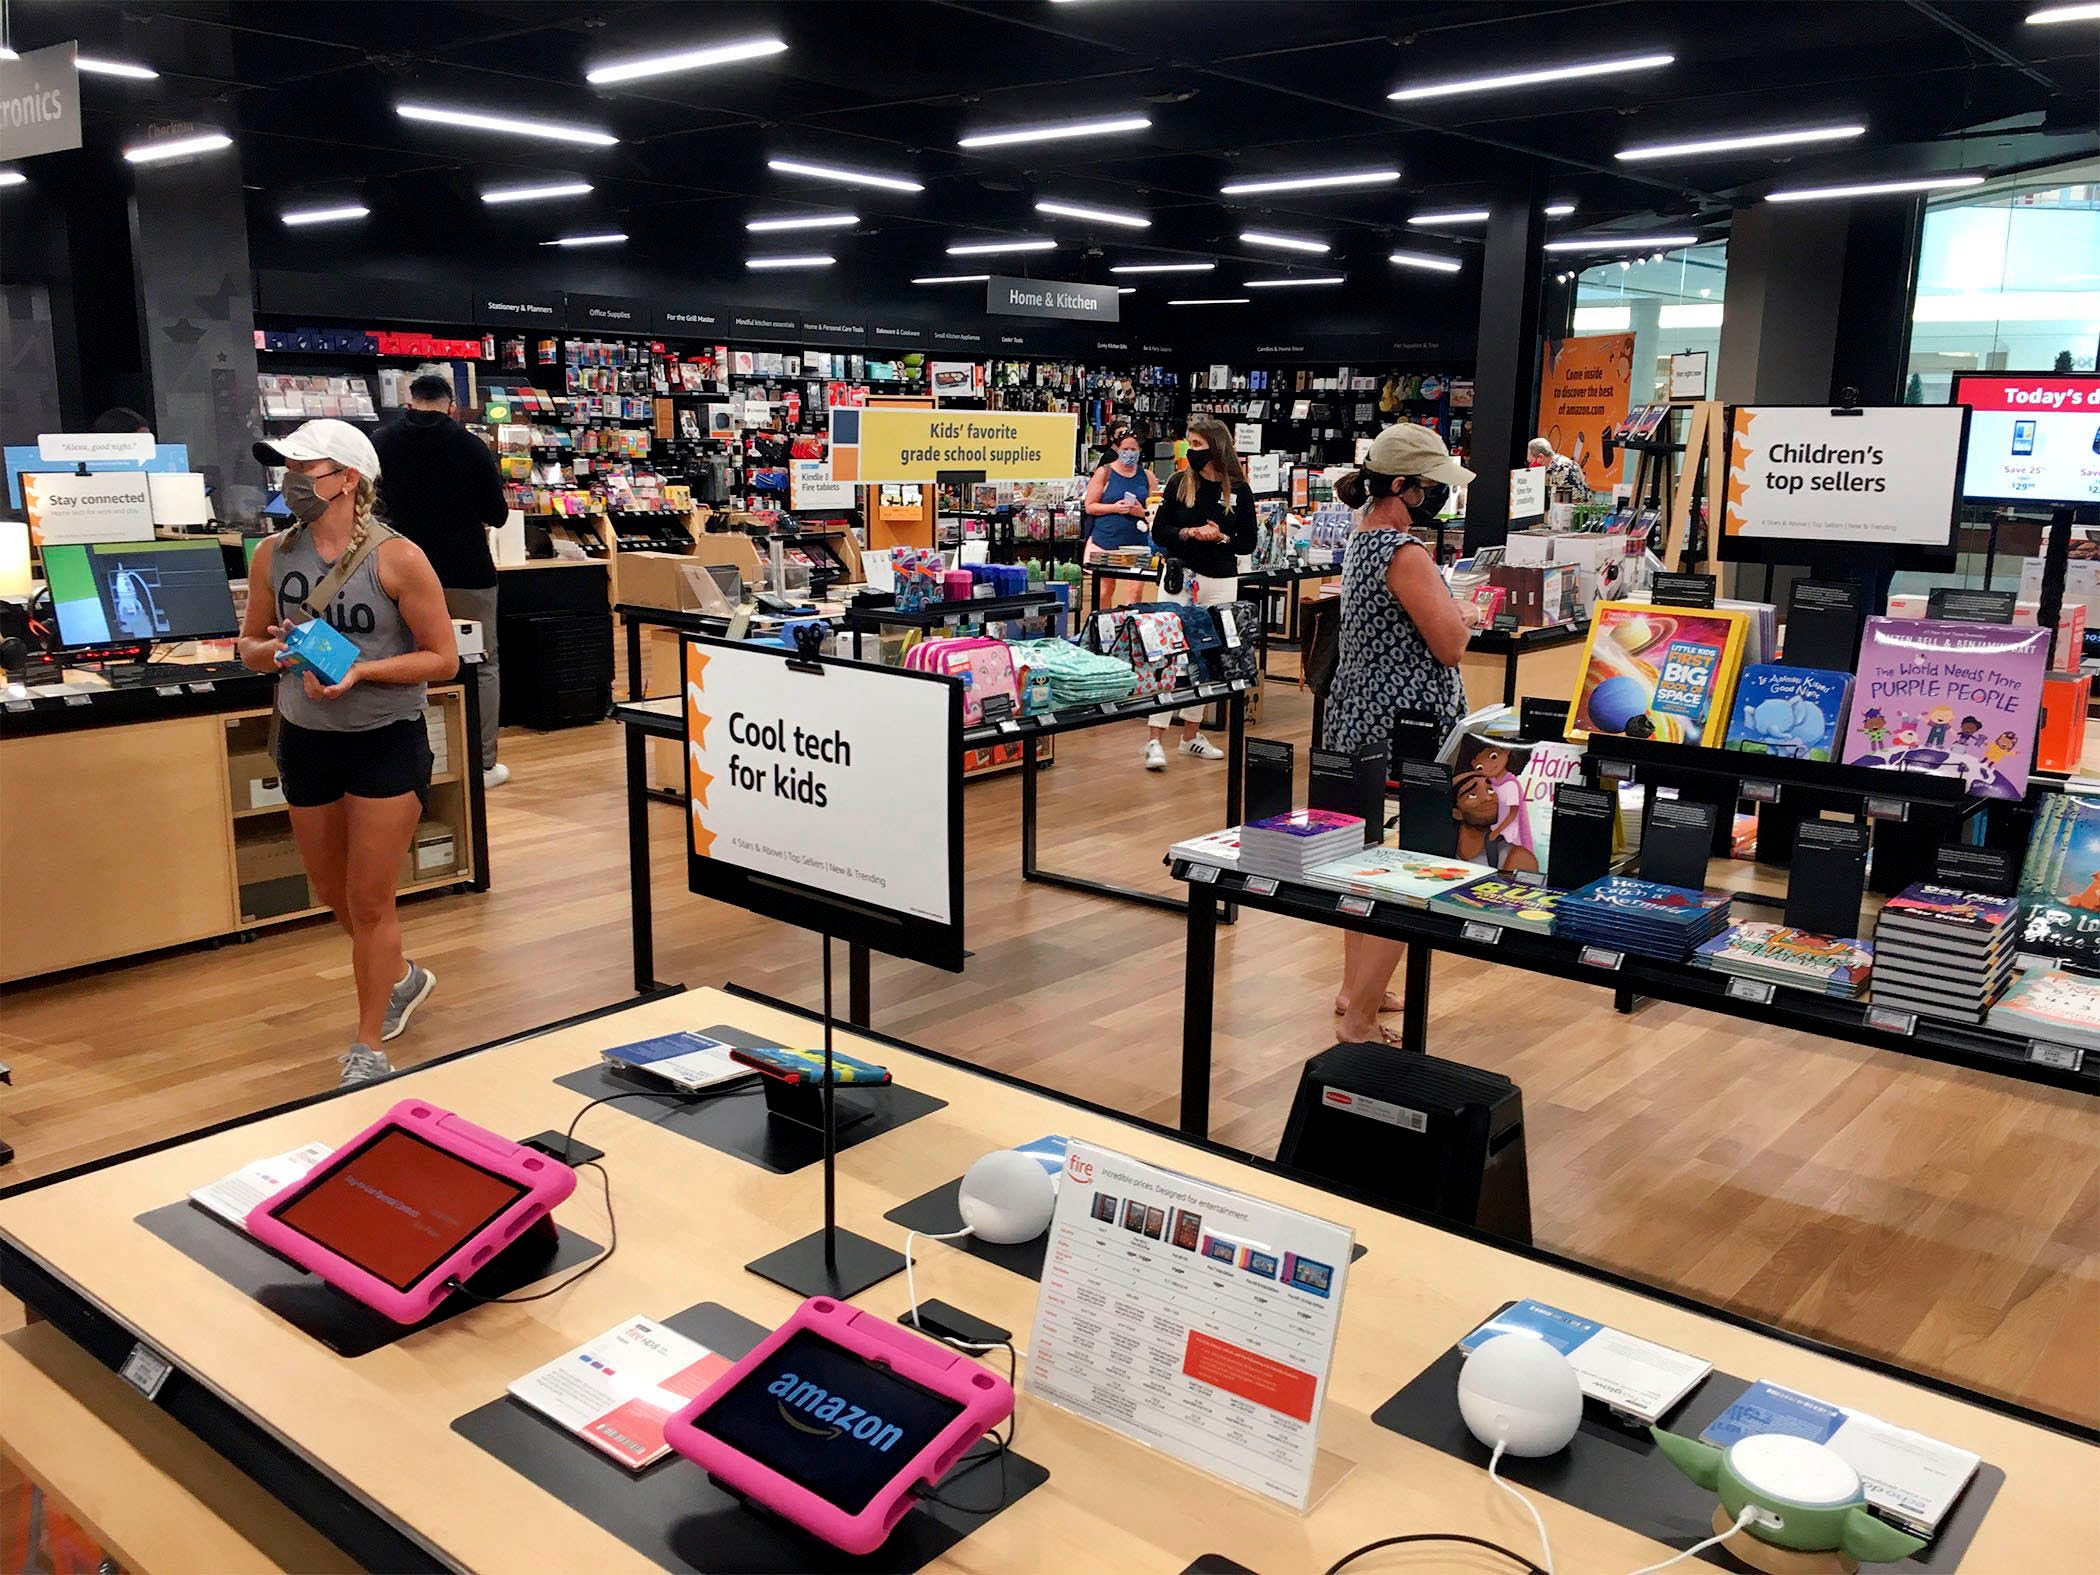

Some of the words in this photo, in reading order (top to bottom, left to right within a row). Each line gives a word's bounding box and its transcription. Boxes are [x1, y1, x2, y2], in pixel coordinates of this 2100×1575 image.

[1009, 289, 1042, 306] Home
[1045, 292, 1054, 307] &
[1056, 293, 1098, 310] Kitchen
[488, 302, 519, 312] Stationery
[527, 305, 552, 314] Planners
[589, 309, 606, 317] Office
[607, 310, 631, 319] Supplies
[755, 319, 772, 327] kitchen
[824, 324, 841, 332] Personal
[1566, 368, 1583, 381] Come
[1584, 367, 1603, 380] inside
[1554, 387, 1562, 398] to
[1562, 386, 1587, 398] discover
[1588, 386, 1598, 397] the
[1599, 386, 1614, 397] best
[2004, 388, 2082, 408] Today's
[1558, 403, 1565, 415] of
[1566, 404, 1605, 416] amazon.com
[930, 423, 965, 439] Kids'
[967, 423, 1017, 440] favorite
[92, 443, 109, 452] good
[1769, 443, 1883, 465] Children's
[901, 447, 940, 465] grade
[944, 446, 986, 462] school
[989, 448, 1041, 466] supplies
[802, 472, 823, 481] Kindle
[2004, 466, 2026, 474] Save
[802, 483, 815, 491] Fire
[816, 482, 840, 491] tablets
[1766, 472, 1803, 494] top
[1810, 472, 1886, 492] sellers
[49, 494, 76, 508] Stay
[81, 492, 144, 505] connected
[1871, 523, 1896, 531] Trending
[1671, 644, 1697, 654] LITTLE
[1699, 648, 1716, 657] KIDS
[1669, 652, 1713, 667] FIRST
[1663, 663, 1708, 686] BIG
[1876, 667, 1894, 677] The
[1900, 662, 1939, 677] World
[1944, 664, 1984, 683] Needs
[1989, 671, 2022, 690] More
[1657, 688, 1702, 704] SPACE
[1770, 684, 1795, 693] Good
[1872, 679, 1941, 699] PURPLE
[1947, 682, 2019, 713] PEOPLE
[729, 712, 786, 753] Cool
[794, 726, 851, 767] tech
[1531, 750, 1582, 779] Hair
[729, 754, 766, 793] for
[774, 764, 828, 808] kids
[1522, 778, 1554, 802] Lov
[737, 838, 754, 851] Stars
[755, 843, 761, 852] &
[762, 845, 783, 858] Above
[788, 851, 801, 865] Top
[802, 855, 825, 870] Sellers
[829, 863, 845, 875] New
[846, 867, 853, 877] &
[855, 869, 887, 888] Trending
[1612, 877, 1655, 889] How
[1594, 886, 1647, 897] Catch
[1592, 893, 1690, 914] Mermaid
[1070, 1154, 1093, 1177] fire
[1102, 1168, 1132, 1185] Incredible
[1134, 1179, 1154, 1191] prices.
[1156, 1184, 1186, 1201] Designed
[1187, 1194, 1198, 1205] for
[1199, 1200, 1250, 1221] entertainment.
[768, 1373, 904, 1452] amazon
